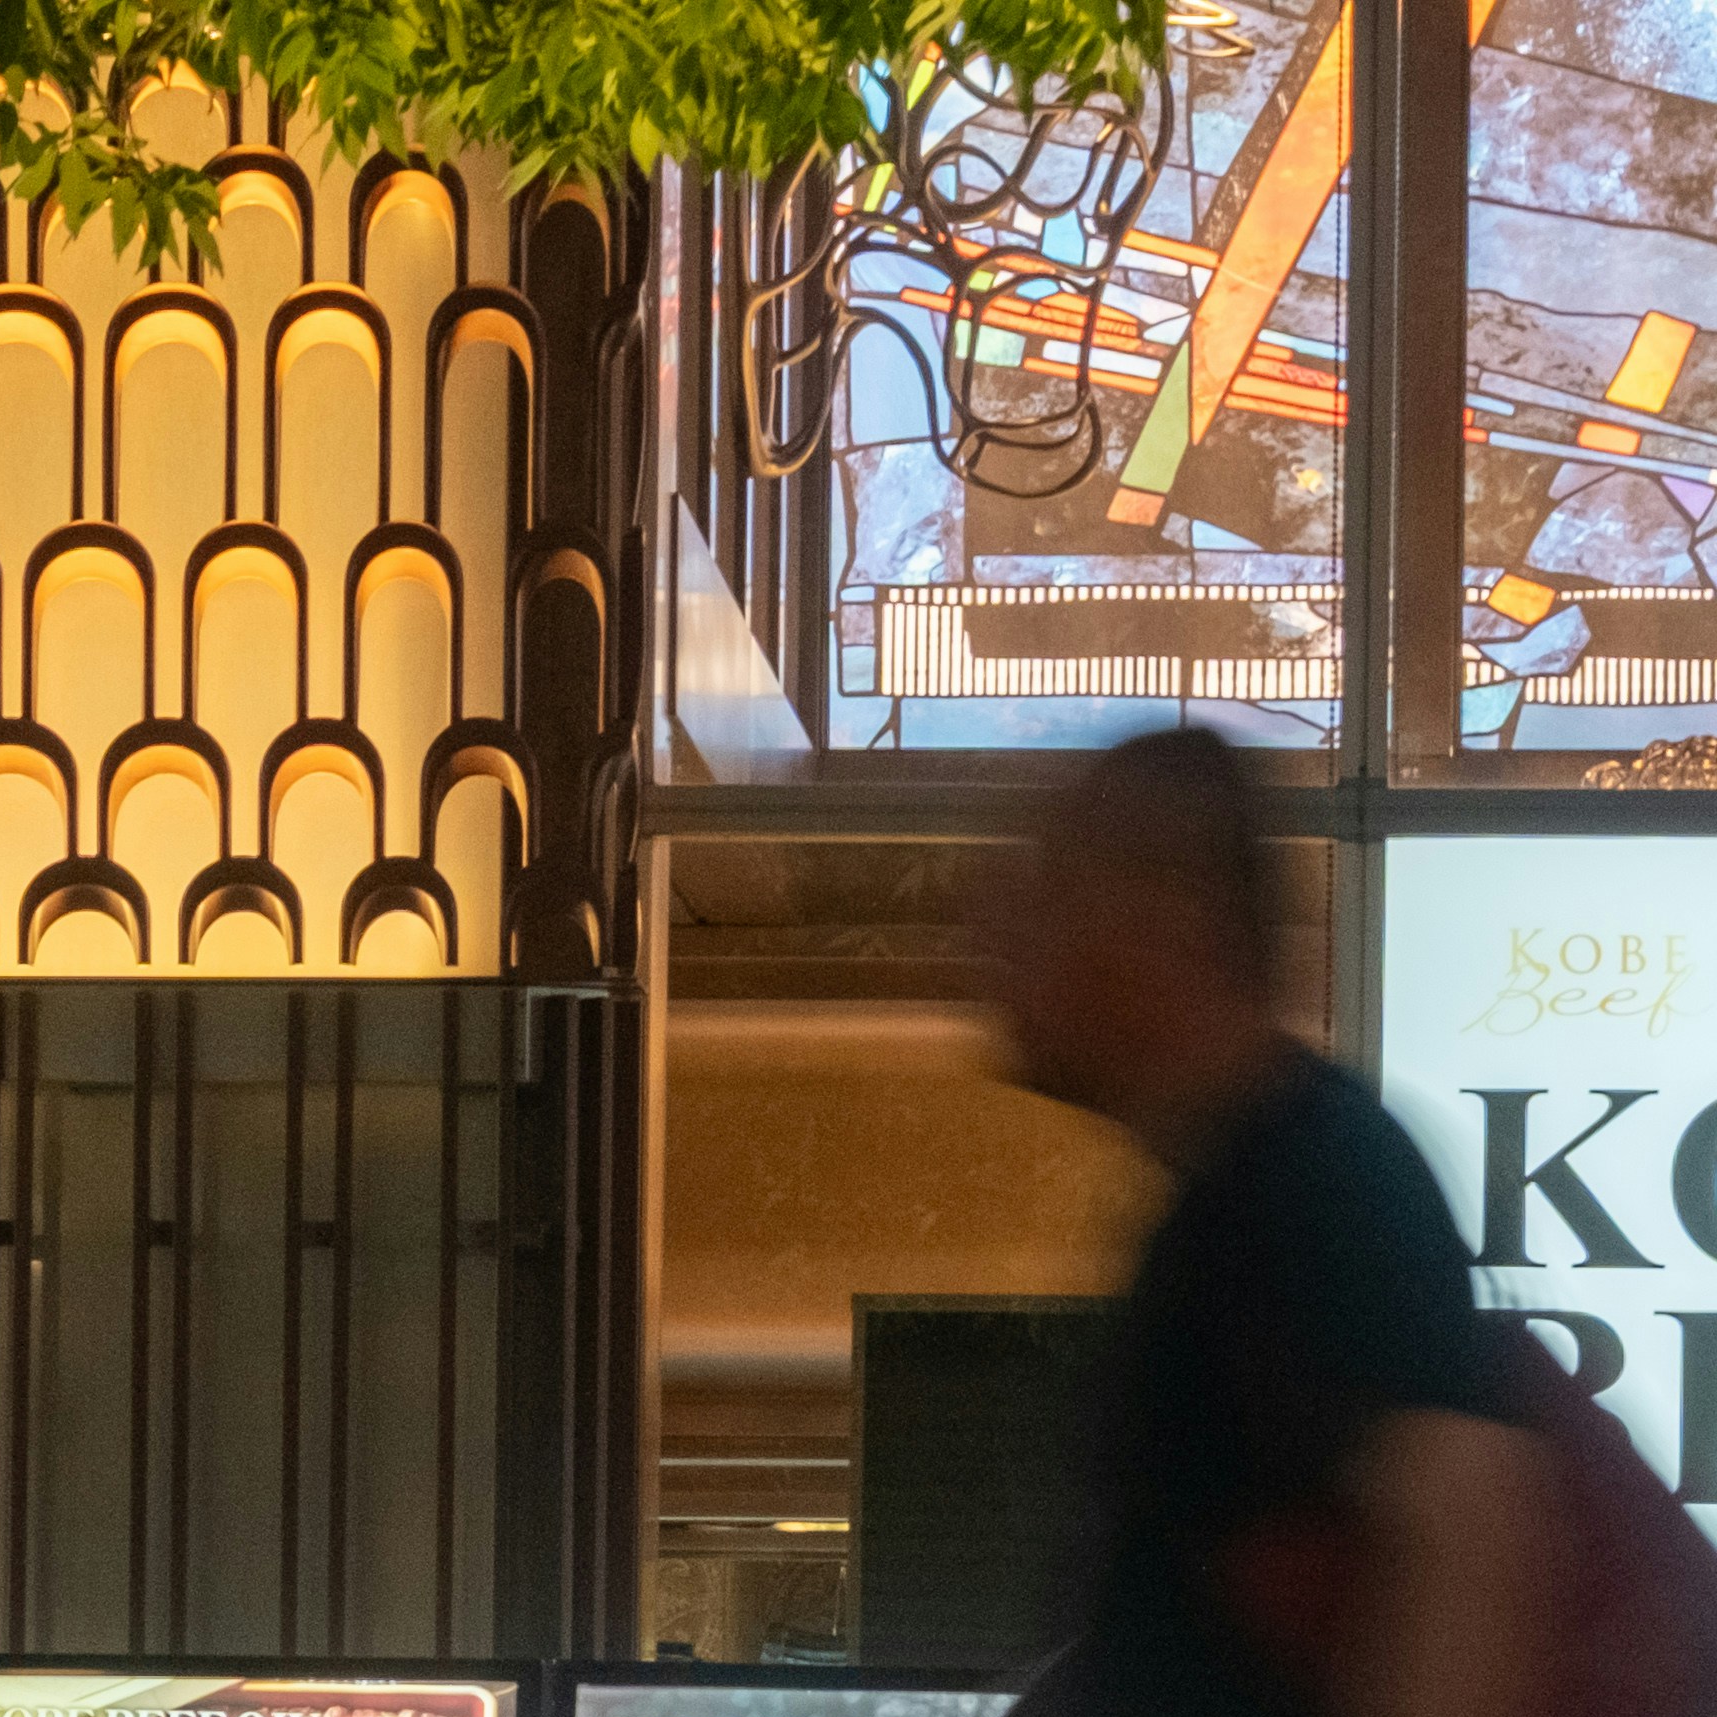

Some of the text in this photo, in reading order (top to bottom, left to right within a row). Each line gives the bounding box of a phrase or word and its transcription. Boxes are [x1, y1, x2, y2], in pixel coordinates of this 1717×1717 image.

[1509, 927, 1687, 975] KOBE
[1461, 955, 1717, 1039] Beef
[1459, 1089, 1717, 1269] K
